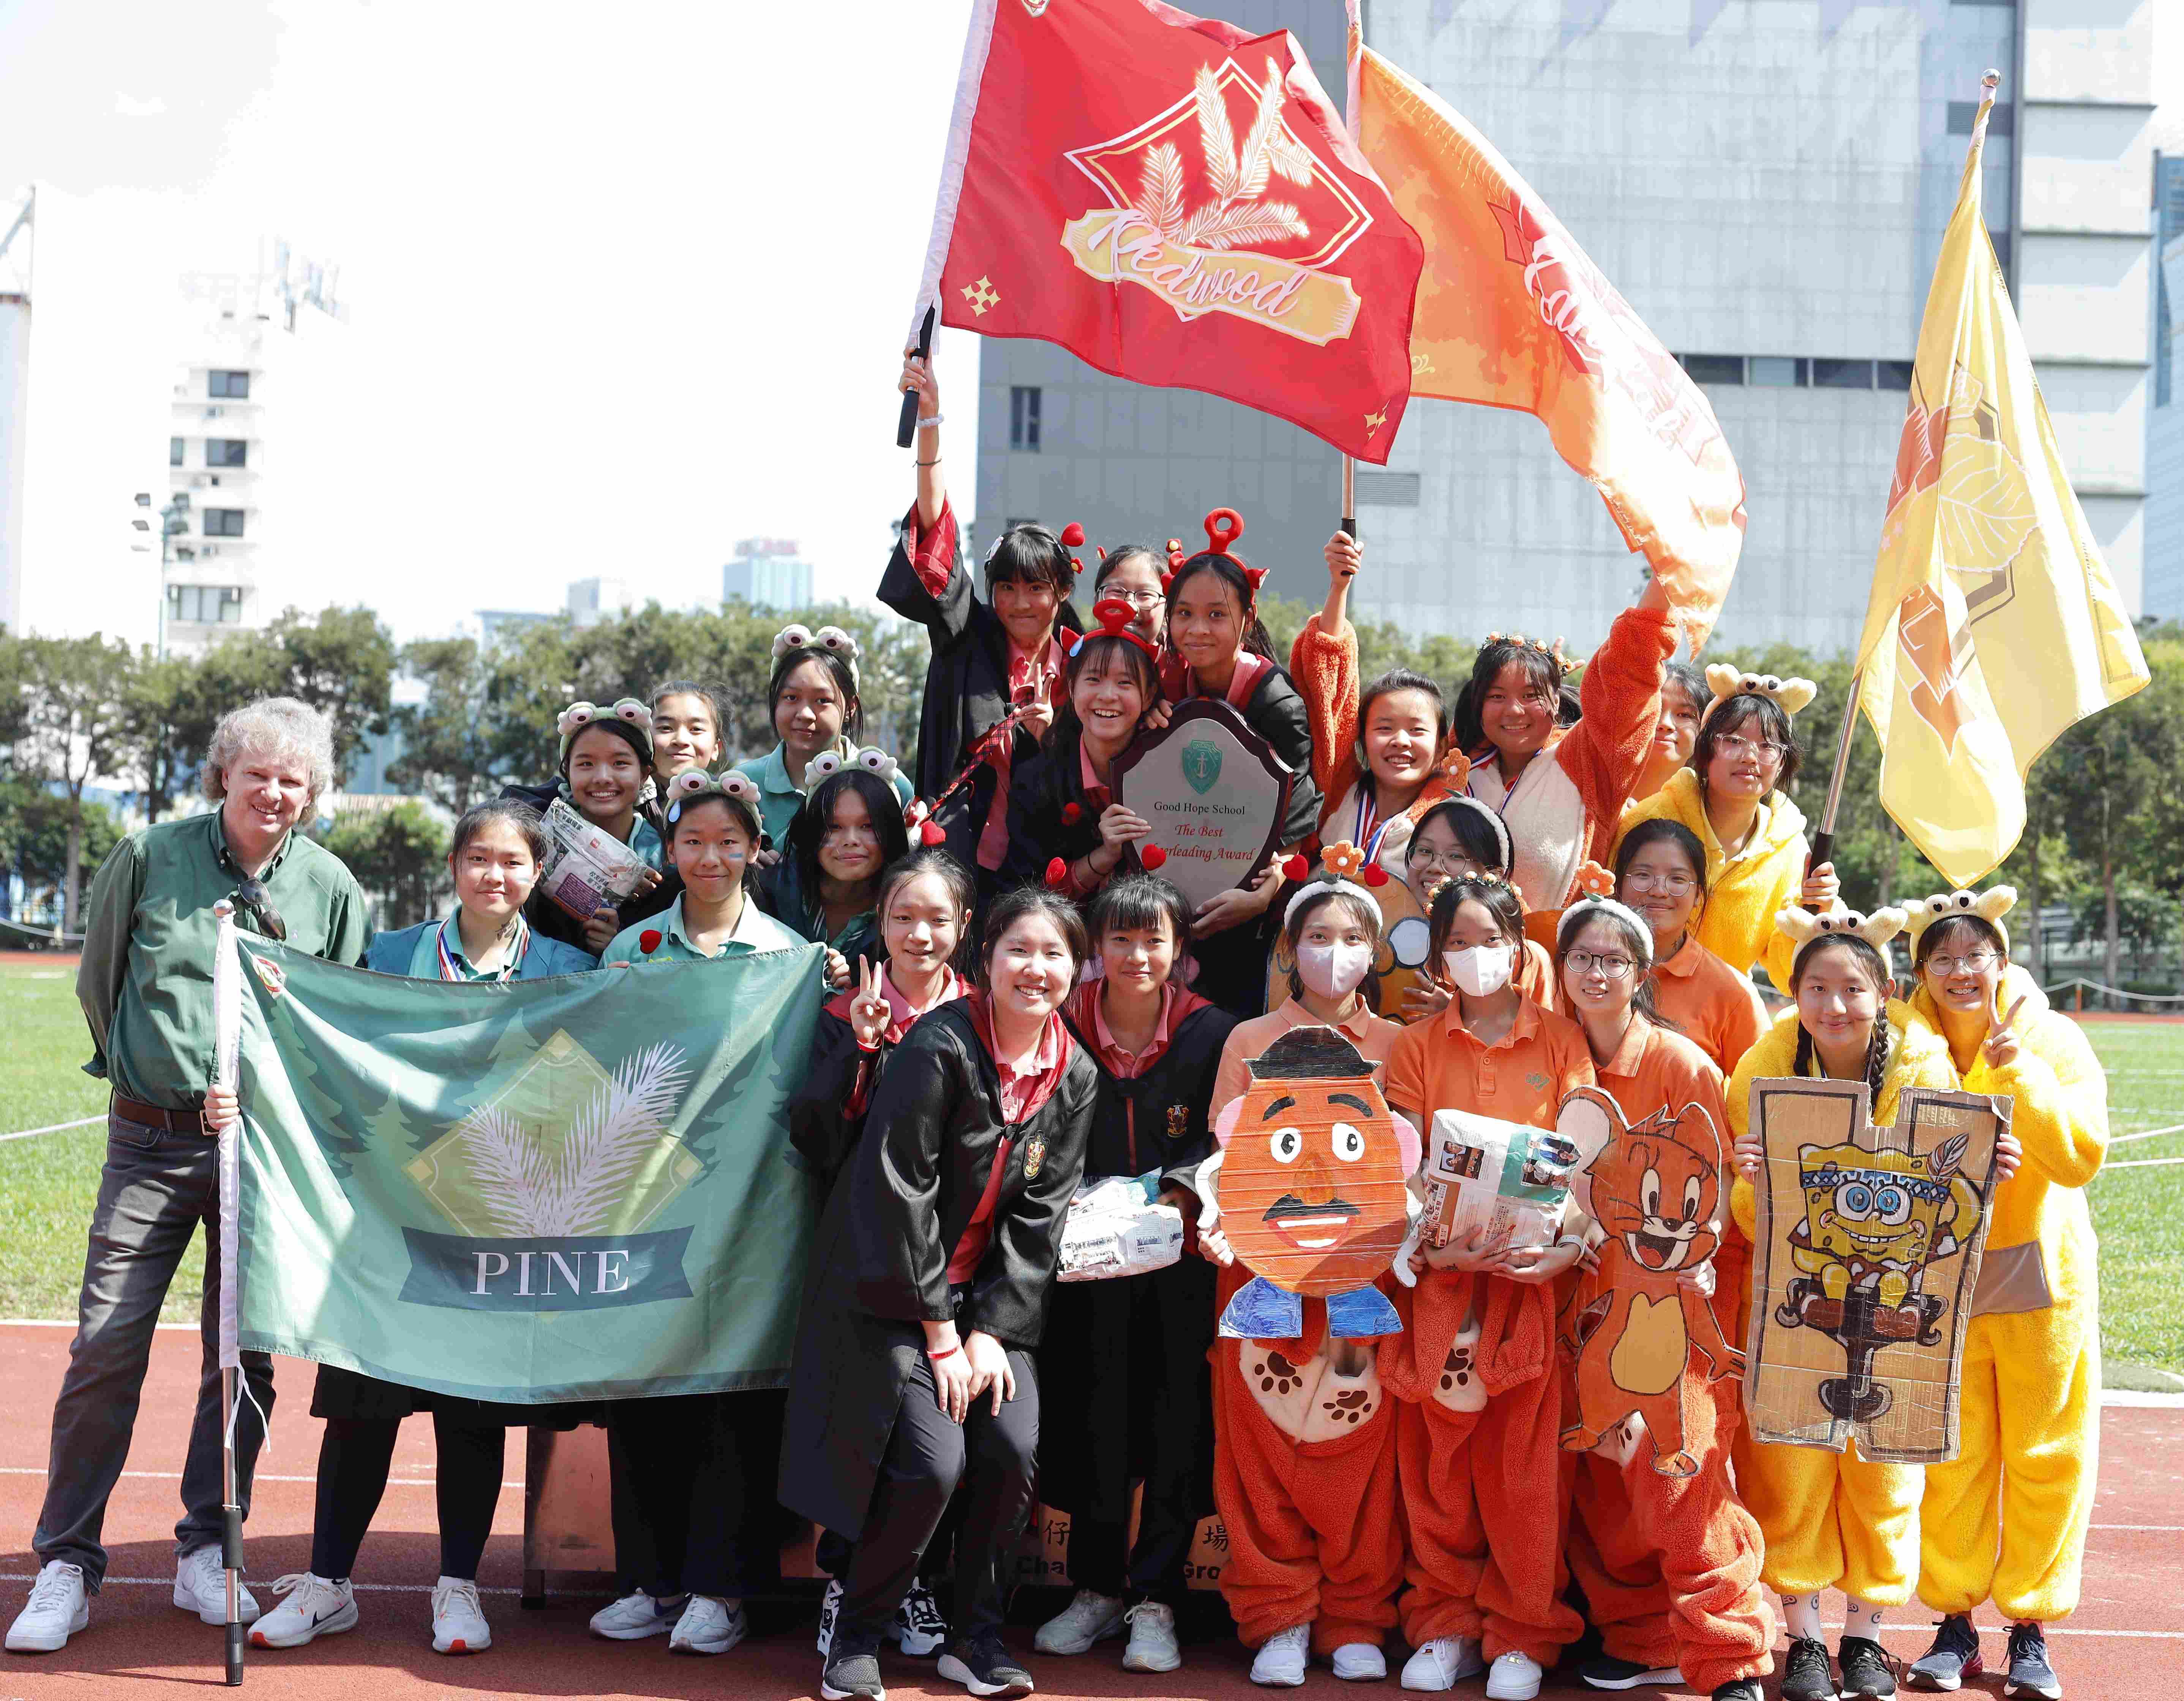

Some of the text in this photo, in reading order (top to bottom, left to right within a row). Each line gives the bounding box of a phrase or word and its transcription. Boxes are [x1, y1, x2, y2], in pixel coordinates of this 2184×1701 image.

[1087, 209, 1310, 317] Redwood
[1154, 802, 1245, 815] Good Hope School
[1175, 824, 1223, 837] The Best
[1213, 847, 1256, 860] Award
[470, 1250, 629, 1295] PINE
[1045, 1520, 1228, 1552] 仔 場
[1017, 1555, 1221, 1579] Cha Gro
